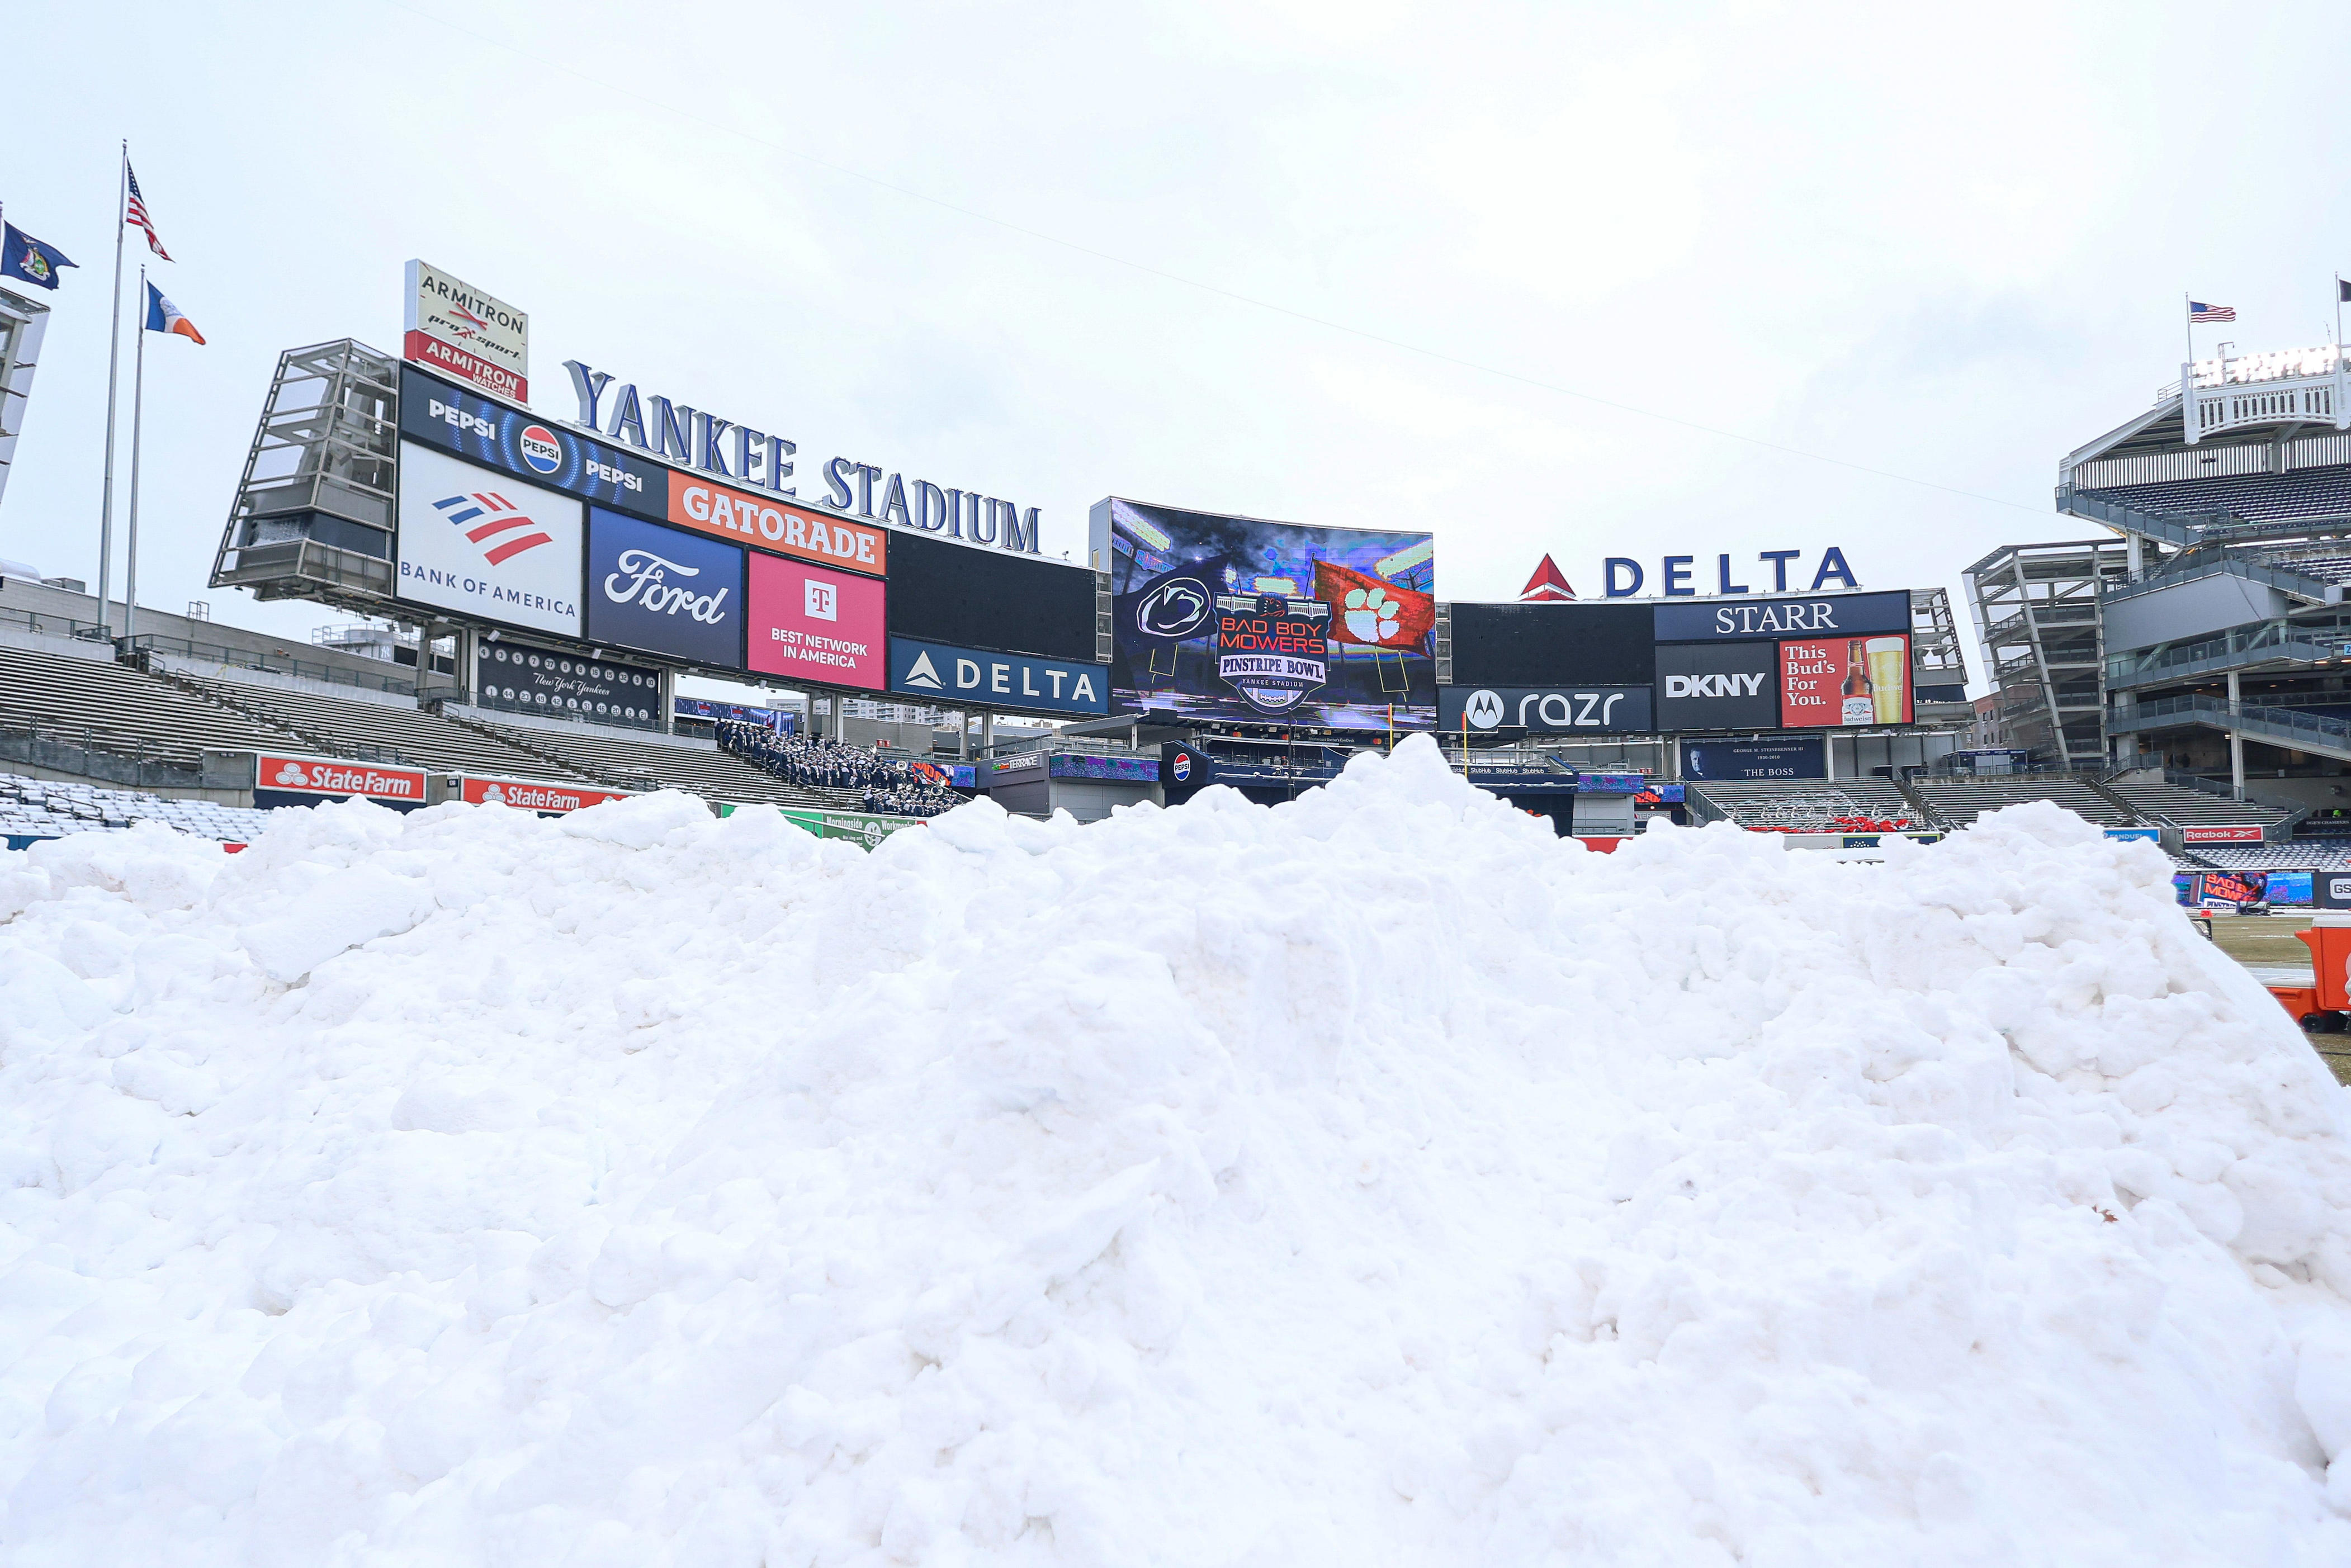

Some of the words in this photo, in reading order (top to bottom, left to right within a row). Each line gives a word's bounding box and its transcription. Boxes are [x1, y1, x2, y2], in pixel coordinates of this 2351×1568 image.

[422, 276, 523, 334] ARMITRON
[427, 342, 518, 390] ARMITRON
[472, 373, 516, 398] WATCHES
[429, 398, 495, 440] PEPSI
[523, 439, 559, 461] PEPSI
[562, 359, 796, 496] YANKEE
[822, 456, 1041, 555] STADIUM
[586, 459, 642, 492] PEPSI
[683, 485, 876, 565] GATORADE
[1603, 547, 1858, 598] DELTA
[400, 561, 456, 589] BANK
[463, 578, 487, 595] OF
[492, 586, 575, 617] AMERICA
[604, 549, 729, 624] Ford
[1222, 617, 1268, 633] BAD
[1276, 622, 1322, 637] BOY
[1716, 602, 1838, 634] STARR
[772, 628, 803, 645] BEST
[806, 634, 868, 656] NETWORK
[1220, 632, 1325, 654] MOWERS
[1785, 645, 1827, 660] This
[784, 645, 797, 659] IN
[799, 648, 856, 669] AMERICA
[1223, 657, 1282, 673] PINSTRIPE
[1287, 660, 1323, 679] BOWL
[1786, 660, 1836, 675] Bud's
[533, 672, 554, 686] New
[554, 676, 575, 693] York
[576, 680, 610, 696] Yankees
[957, 658, 1096, 703] DELTA
[1666, 672, 1766, 699] DKNY
[1787, 677, 1818, 691] For
[1519, 693, 1624, 726] razr
[1787, 692, 1827, 706] You.
[1009, 756, 1038, 769] TERRACE
[1768, 768, 1794, 776] BOSS
[826, 816, 863, 828] Morningside
[2206, 874, 2235, 889] BAD
